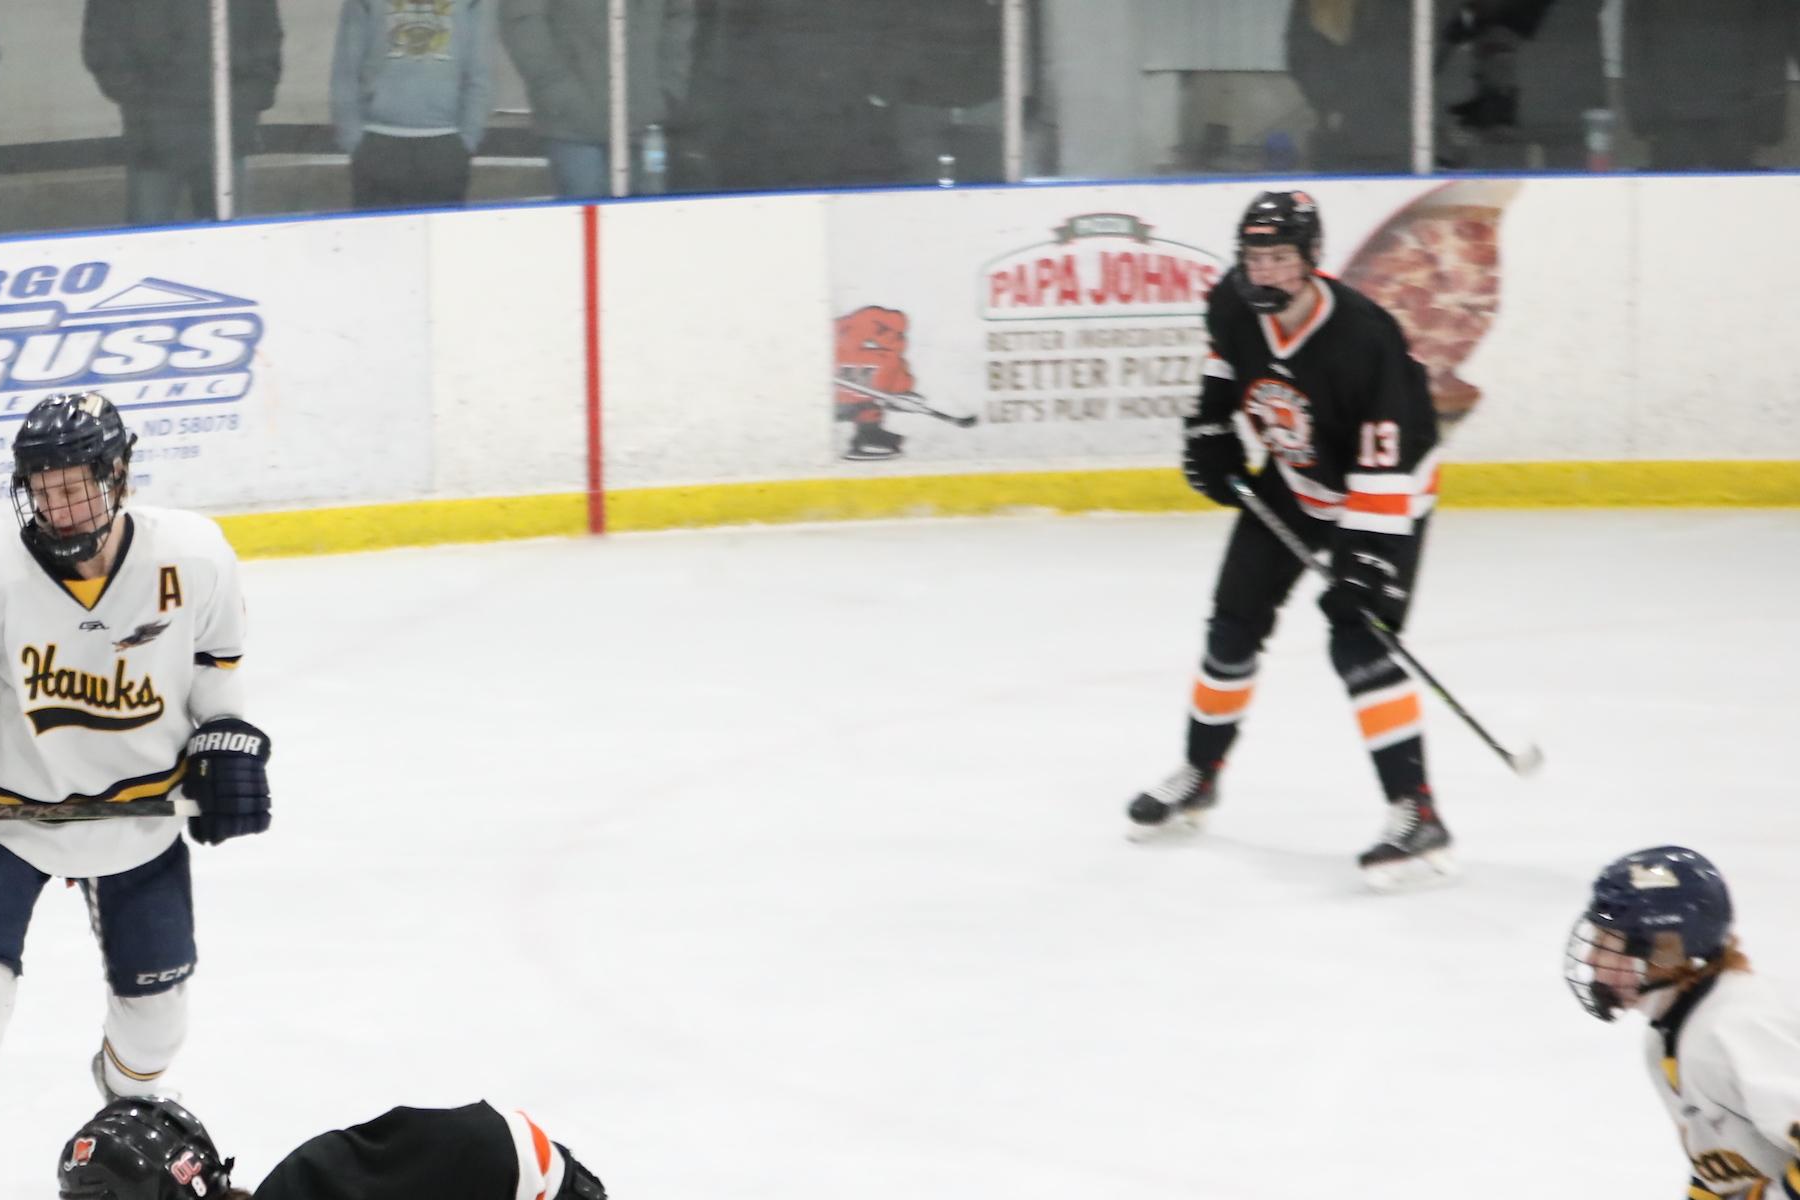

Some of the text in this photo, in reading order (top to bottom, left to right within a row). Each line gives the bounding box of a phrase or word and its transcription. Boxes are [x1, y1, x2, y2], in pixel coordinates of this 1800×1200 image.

[988, 254, 1081, 307] PAPA
[987, 327, 1206, 351] BETTER INGREDIENT
[987, 355, 1202, 391] BETTER PIZZ
[1117, 395, 1200, 419] HOCK
[143, 418, 172, 437] ND
[1357, 420, 1400, 467] 13
[158, 566, 184, 613] A
[21, 643, 165, 711] Hawks
[186, 732, 261, 757] ARRIOR
[136, 963, 191, 985] CCM
